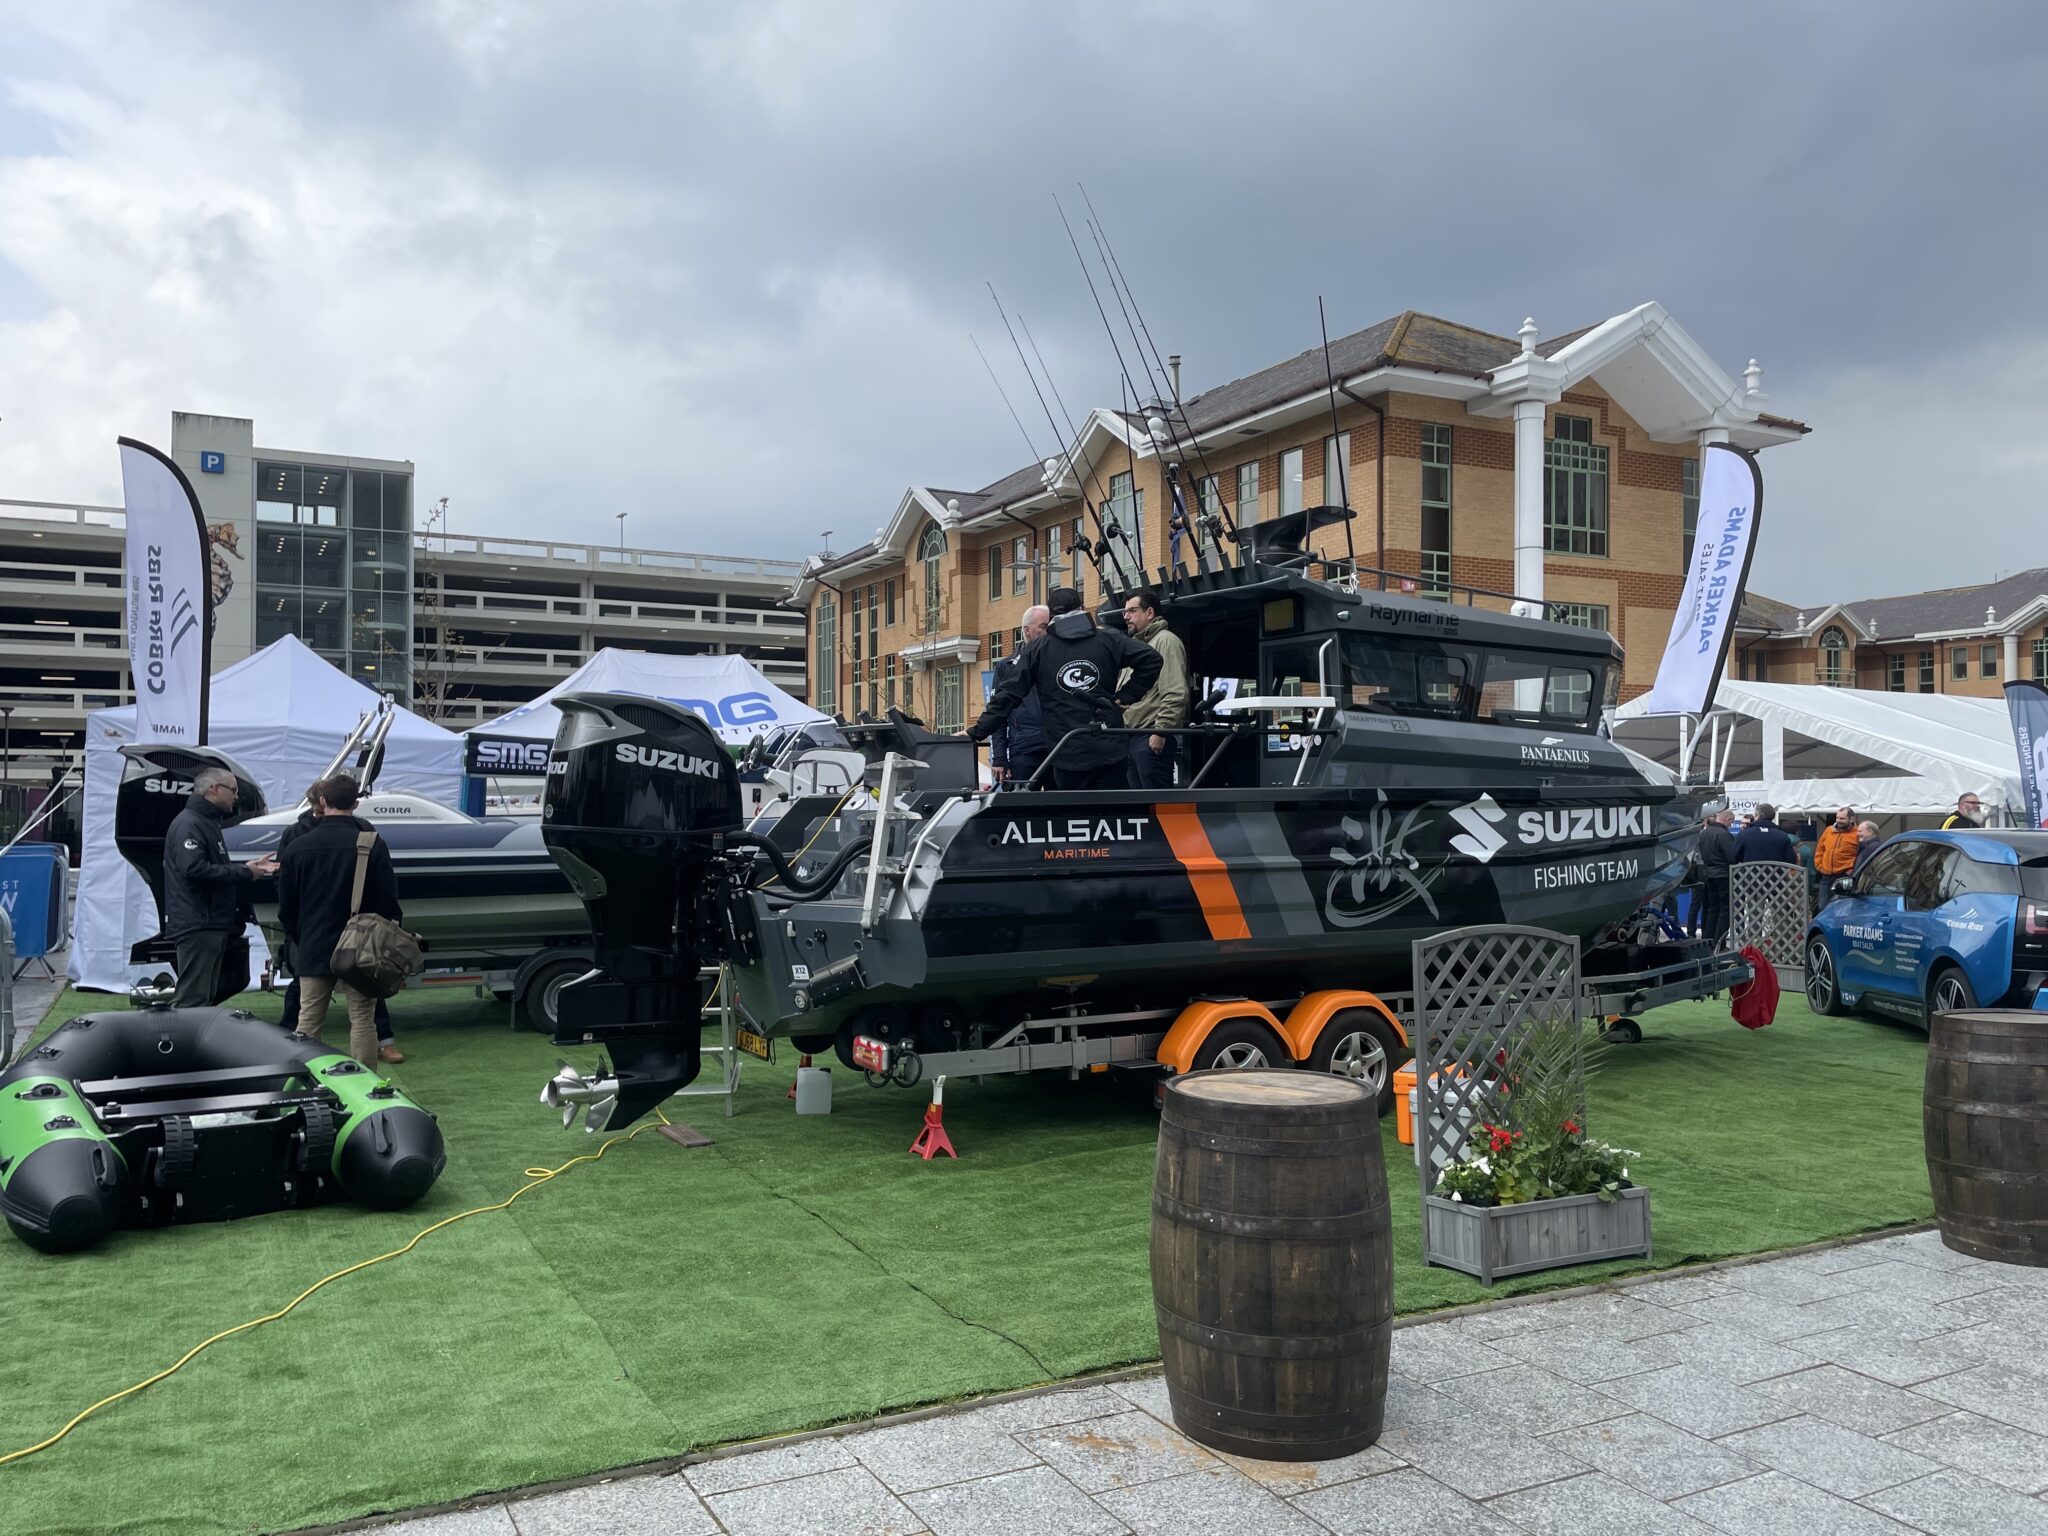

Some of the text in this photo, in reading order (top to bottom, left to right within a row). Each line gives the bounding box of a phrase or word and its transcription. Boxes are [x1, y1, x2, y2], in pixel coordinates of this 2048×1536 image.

[207, 455, 220, 468] P
[1370, 603, 1460, 626] Raymarine
[476, 741, 549, 765] SMG
[615, 743, 719, 780] SUZUKI
[1520, 745, 1590, 763] PANTAENIUS
[476, 761, 548, 771] DISTRIBUTION
[550, 761, 569, 775] 00
[144, 778, 195, 795] SUZ
[373, 806, 411, 814] COBRA
[1731, 801, 1760, 809] SHOW
[1001, 818, 1149, 845] ALLSALT
[1518, 805, 1652, 844] SUZUKI
[1044, 848, 1110, 860] MARITIME
[1534, 859, 1638, 889] FISHING TEAM
[1843, 925, 1864, 938] PARKER
[1864, 927, 1884, 942] ADAMS
[795, 966, 807, 976] X12
